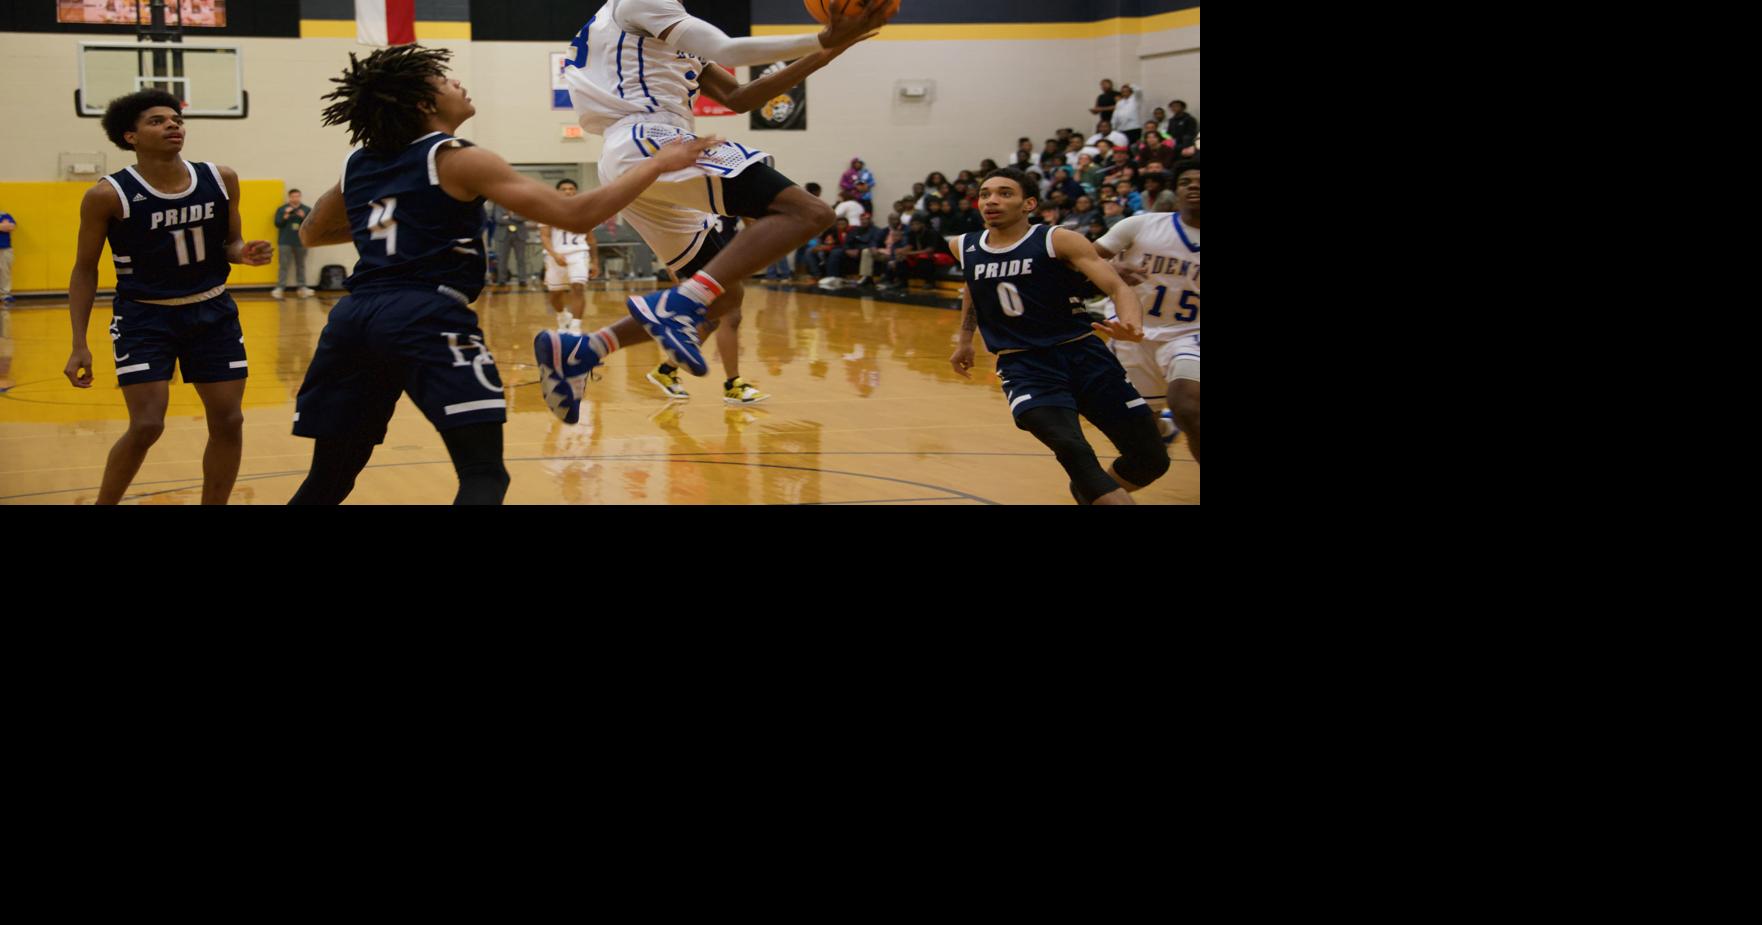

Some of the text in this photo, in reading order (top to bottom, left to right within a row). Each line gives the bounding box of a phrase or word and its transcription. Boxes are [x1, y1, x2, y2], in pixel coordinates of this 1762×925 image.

[150, 201, 215, 230] PRIDE
[367, 197, 397, 256] 4
[169, 226, 206, 266] 11
[974, 258, 1033, 280] PRIDE
[996, 281, 1025, 317] 0
[1148, 285, 1200, 322] 15
